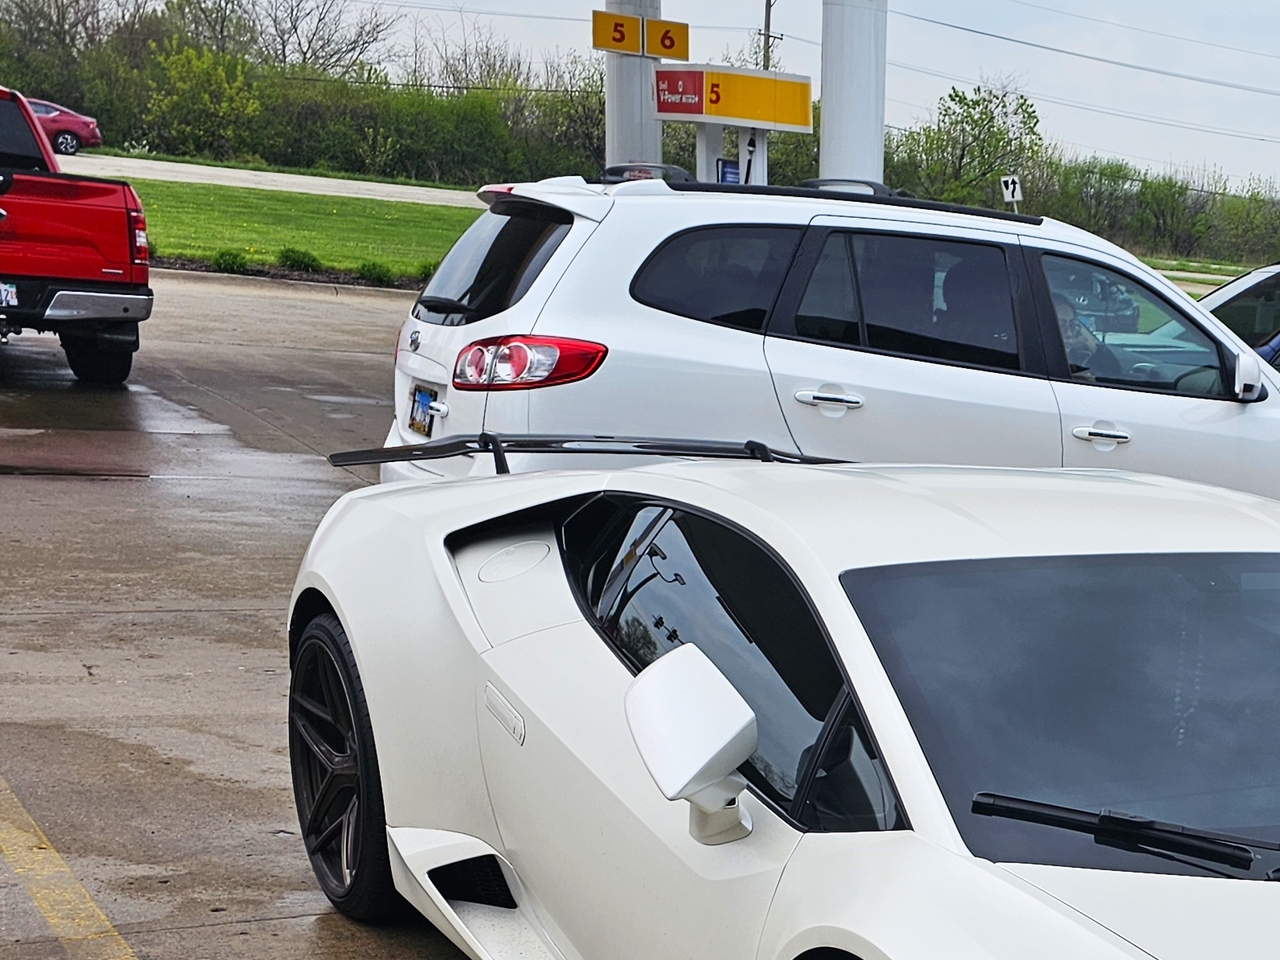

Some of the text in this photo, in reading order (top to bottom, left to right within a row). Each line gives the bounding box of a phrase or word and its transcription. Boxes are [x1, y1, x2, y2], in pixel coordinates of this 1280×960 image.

[611, 21, 626, 44] 5
[660, 29, 675, 50] 6
[709, 83, 721, 105] 5
